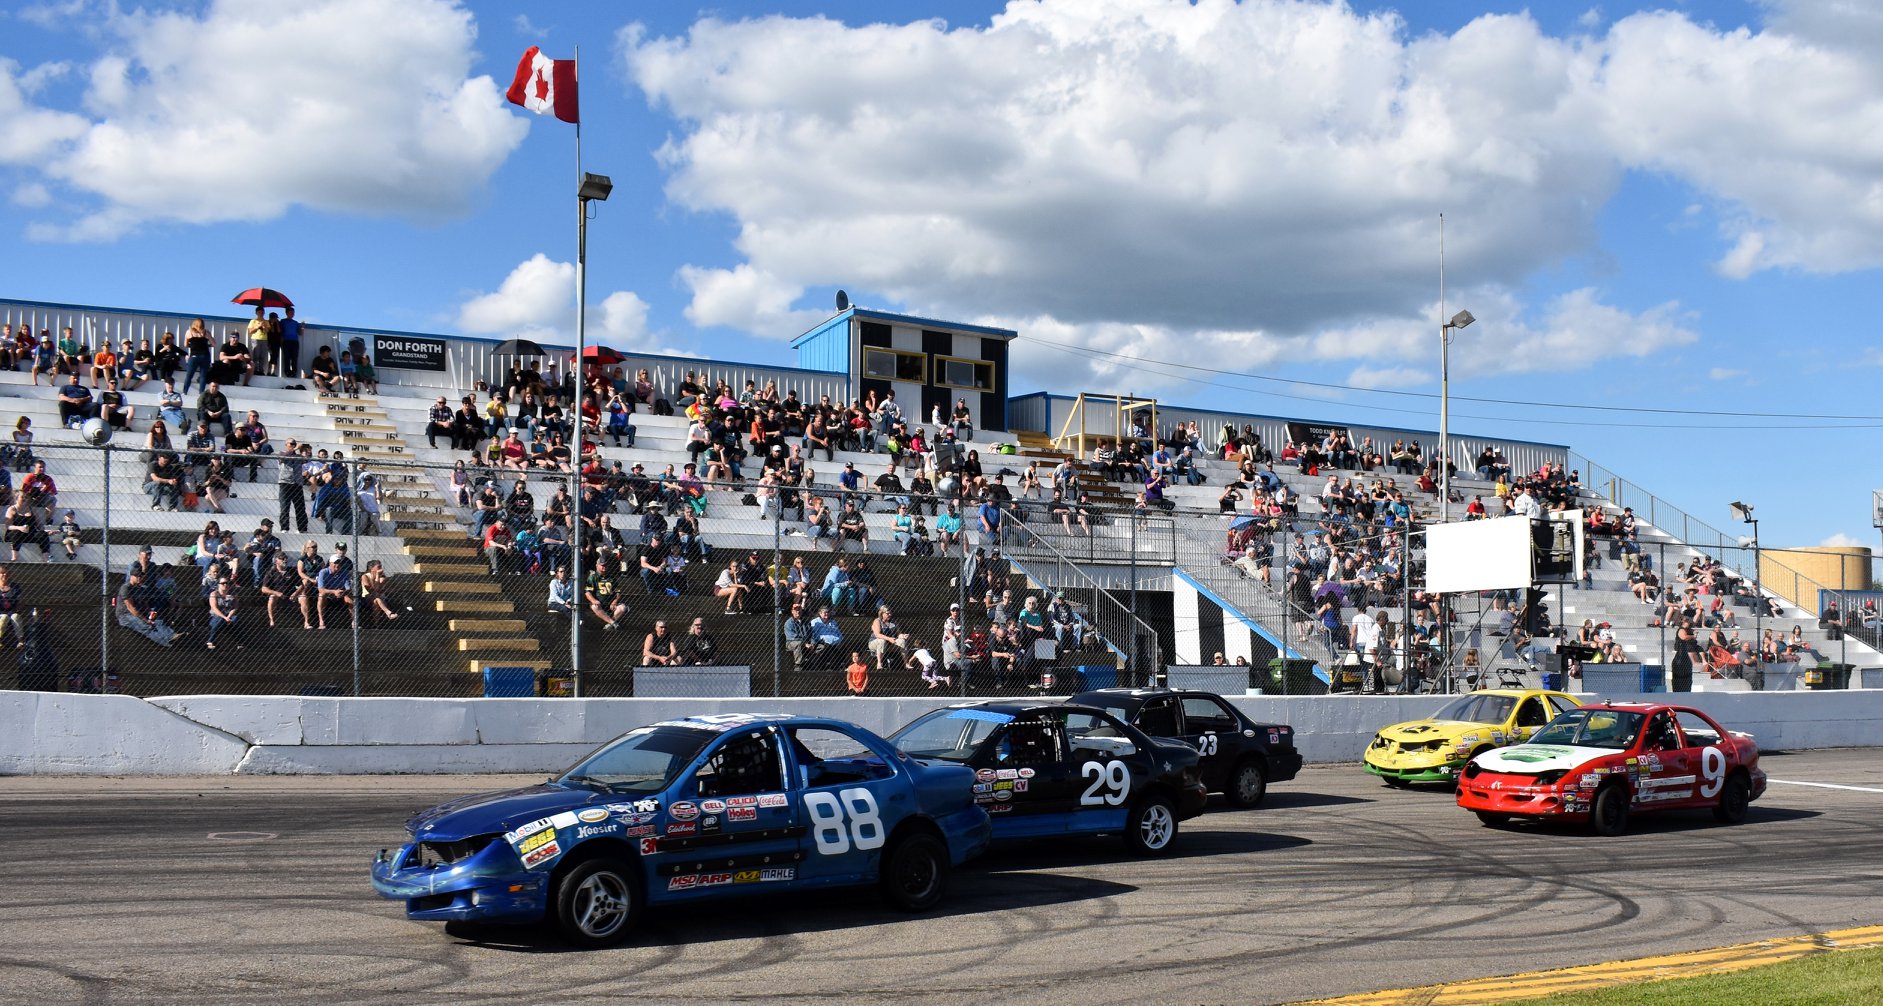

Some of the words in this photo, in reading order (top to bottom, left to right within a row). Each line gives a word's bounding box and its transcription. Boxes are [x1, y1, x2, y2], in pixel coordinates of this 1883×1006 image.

[377, 340, 403, 350] DON
[405, 342, 442, 353] FORTH
[1198, 735, 1218, 757] 23
[1700, 746, 1726, 798] 9
[1015, 780, 1027, 790] CV
[1080, 760, 1131, 806] 29
[704, 802, 723, 810] BELL
[727, 796, 756, 806] CALICO
[728, 808, 756, 819] Holley
[803, 787, 886, 855] 88
[507, 822, 538, 841] Mobil
[577, 822, 618, 838] Hoosier
[667, 823, 696, 834] Edelbrock
[518, 827, 556, 855] JEGS
[670, 874, 697, 886] MSD
[698, 873, 732, 885] ARP
[760, 868, 794, 880] MAHLE
